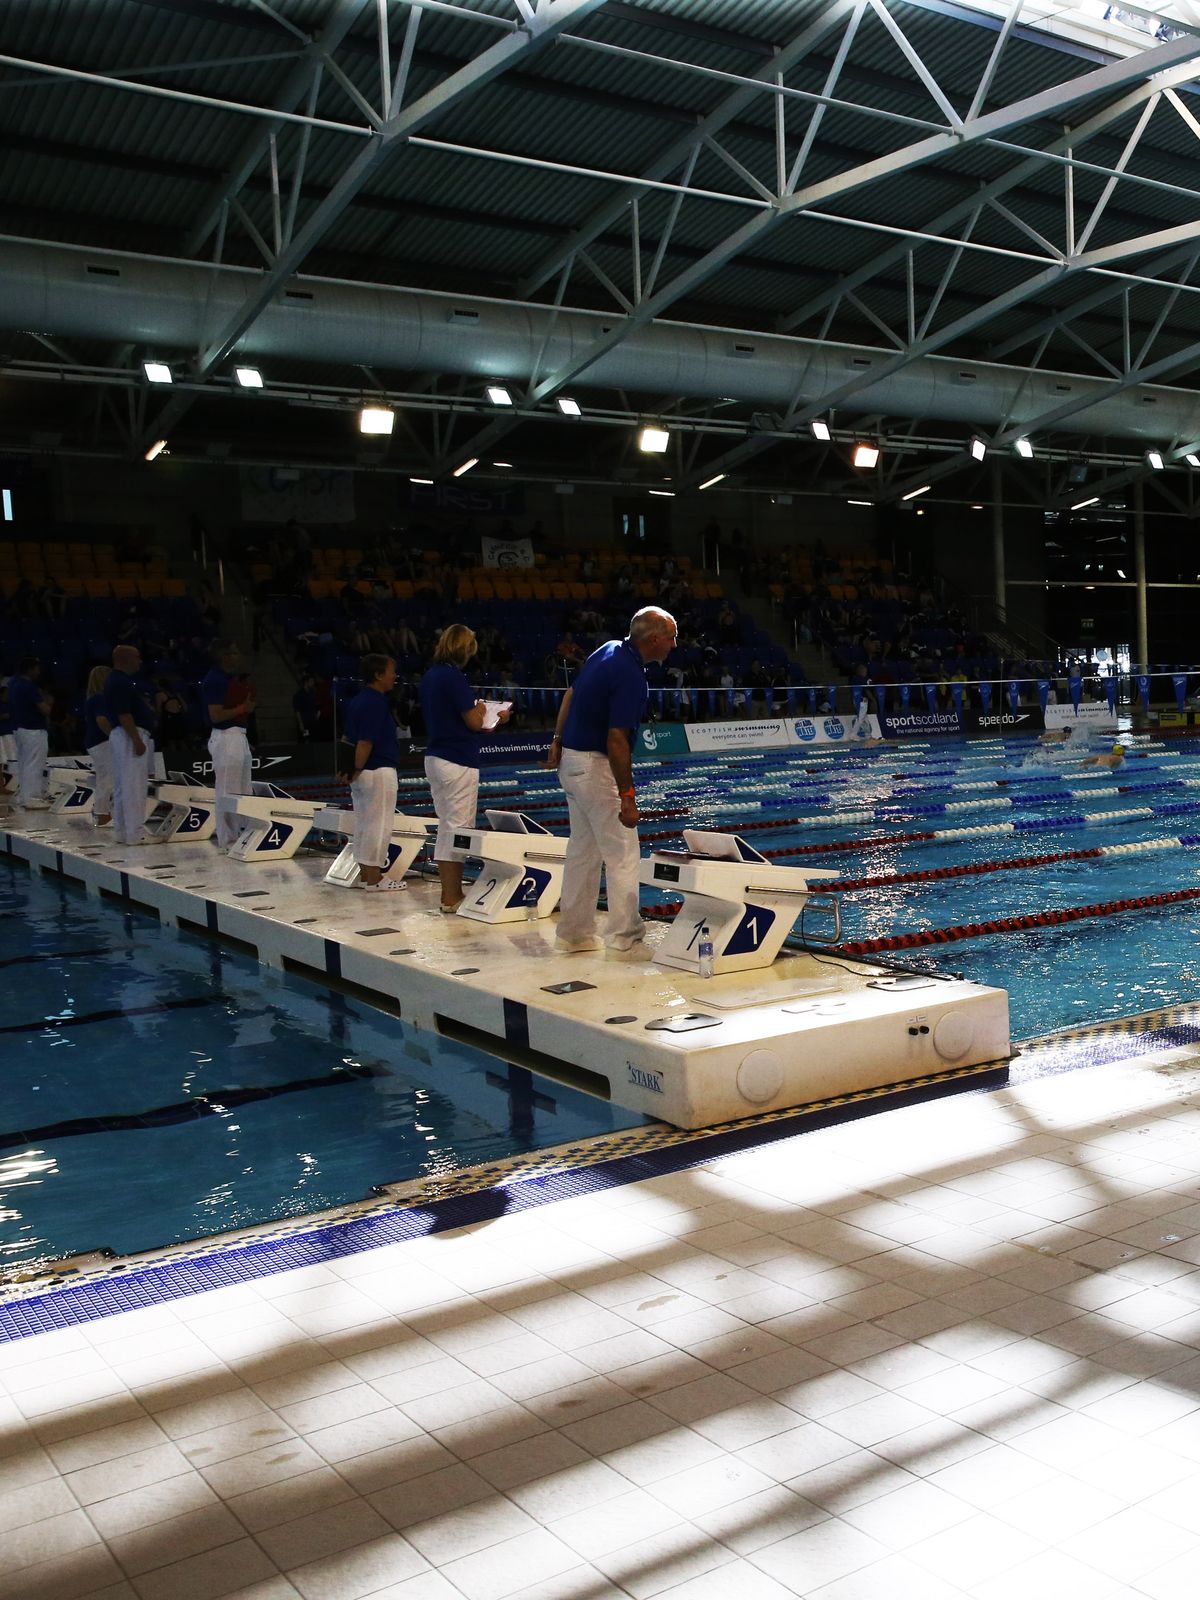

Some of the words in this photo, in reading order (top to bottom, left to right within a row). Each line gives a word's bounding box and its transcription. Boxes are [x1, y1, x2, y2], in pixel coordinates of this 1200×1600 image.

[885, 712, 959, 728] sportscotland
[979, 715, 1015, 727] speedo
[76, 790, 85, 803] 7
[189, 813, 200, 829] 5
[267, 829, 281, 846] 4
[476, 878, 497, 906] 2
[523, 877, 538, 902] 2
[686, 917, 708, 951] 1
[746, 916, 759, 945] 1
[631, 1067, 661, 1091] STARK
